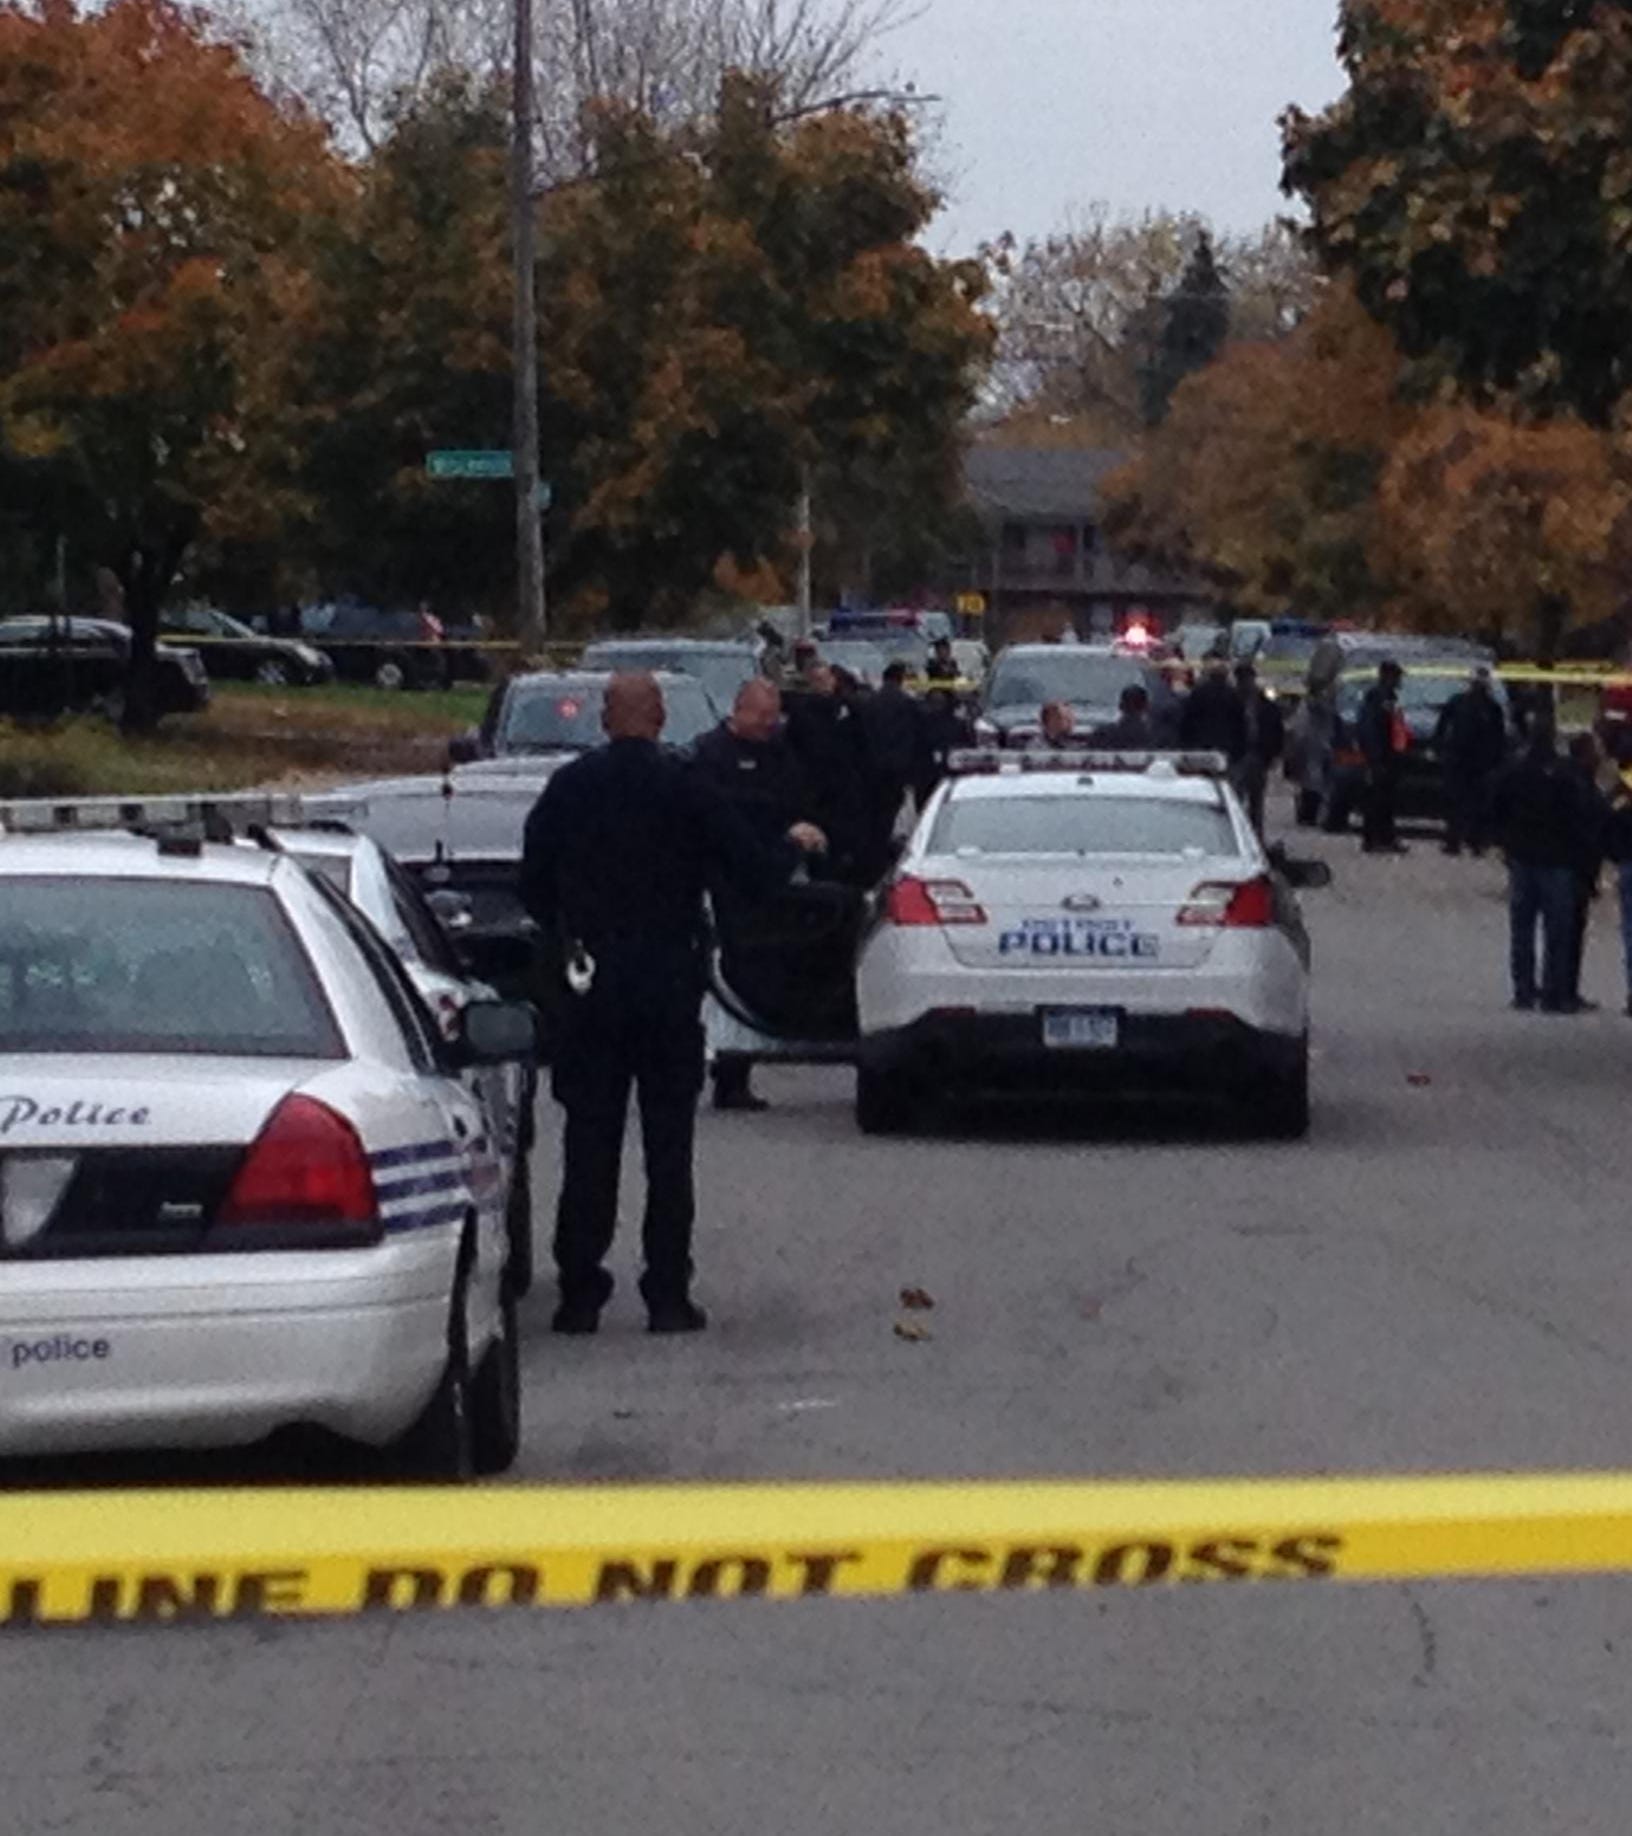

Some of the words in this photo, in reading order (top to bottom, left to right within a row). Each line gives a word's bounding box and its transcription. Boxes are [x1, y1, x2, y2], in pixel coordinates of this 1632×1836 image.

[998, 931, 1159, 957] POLICE
[0, 1094, 150, 1134] Police
[11, 1333, 110, 1369] police
[5, 1570, 309, 1625] LINE
[361, 1564, 539, 1610] DO
[595, 1551, 863, 1604] NOT
[904, 1534, 1342, 1591] CROSS
